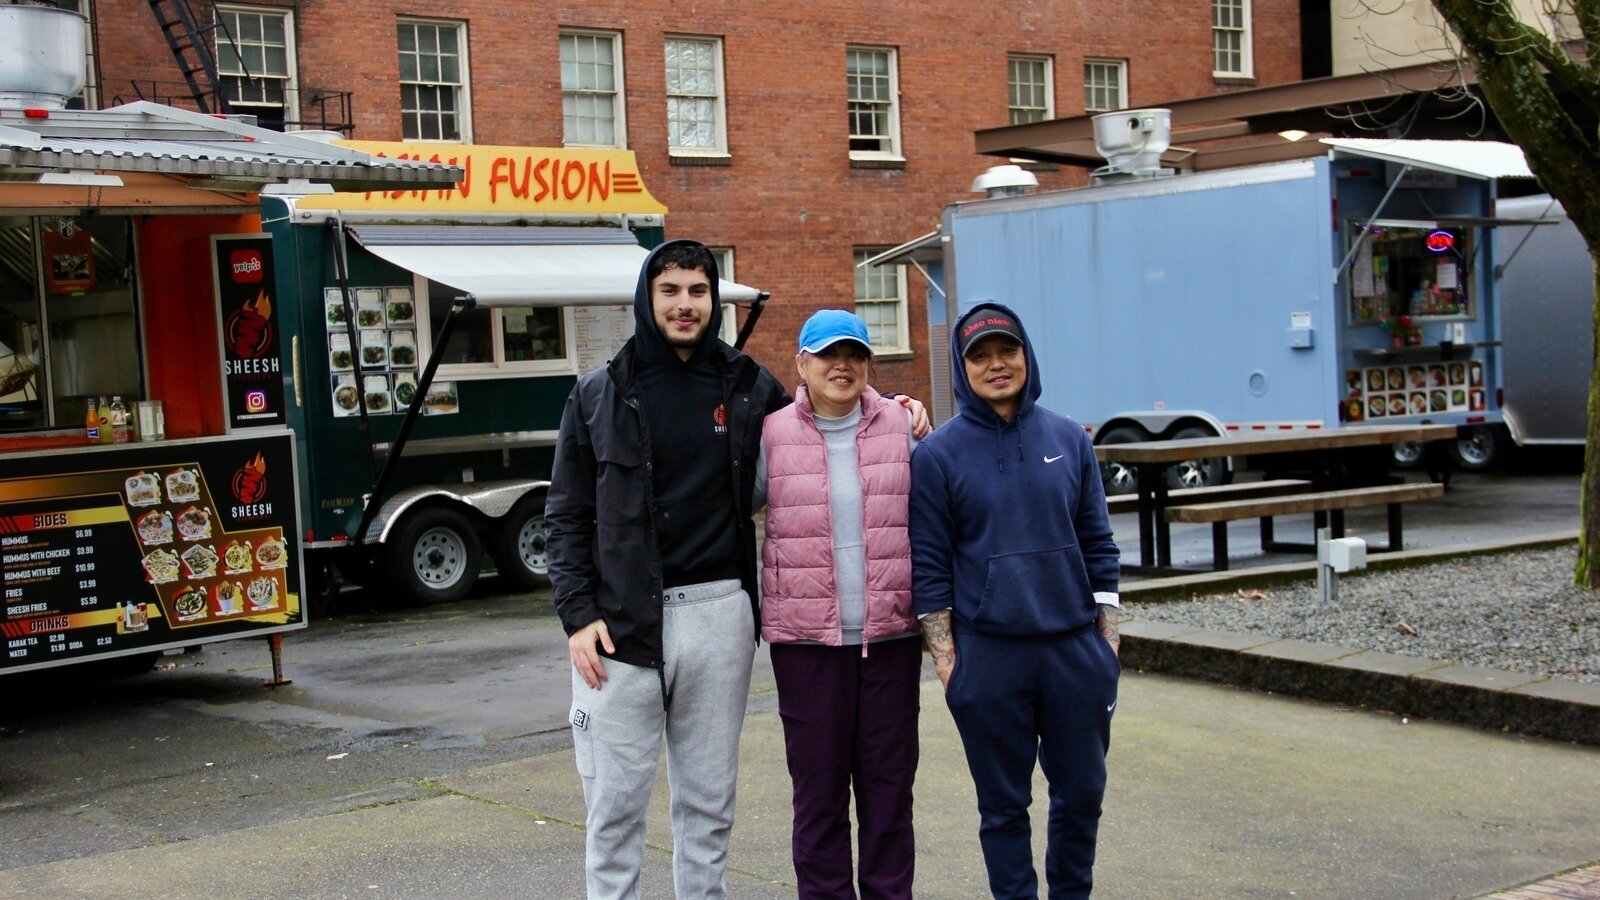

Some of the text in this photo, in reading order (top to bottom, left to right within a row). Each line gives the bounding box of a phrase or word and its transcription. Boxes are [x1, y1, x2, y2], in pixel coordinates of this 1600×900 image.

[489, 155, 609, 203] FUSION
[233, 261, 252, 273] yelp
[225, 358, 279, 375] SHEESH
[231, 503, 273, 518] SHEESH
[33, 513, 68, 529] SIDES
[1, 529, 93, 546] HUMMUS $6.99
[3, 546, 94, 564] HUMMUS WITH CHICKEN $9.99
[4, 570, 31, 581] HUMMUS
[31, 568, 47, 578] WITH
[47, 566, 61, 576] BEEF
[75, 562, 95, 572] $10.99
[5, 579, 96, 598] FRIES $3.99
[7, 604, 30, 615] SHEESH
[30, 602, 48, 612] FRIES
[80, 596, 98, 606] $5.99
[30, 617, 70, 632] DRINKS
[8, 633, 65, 648] KARAK TEA $2.99
[9, 636, 112, 658] WATER $1.99 SODA $2.50
